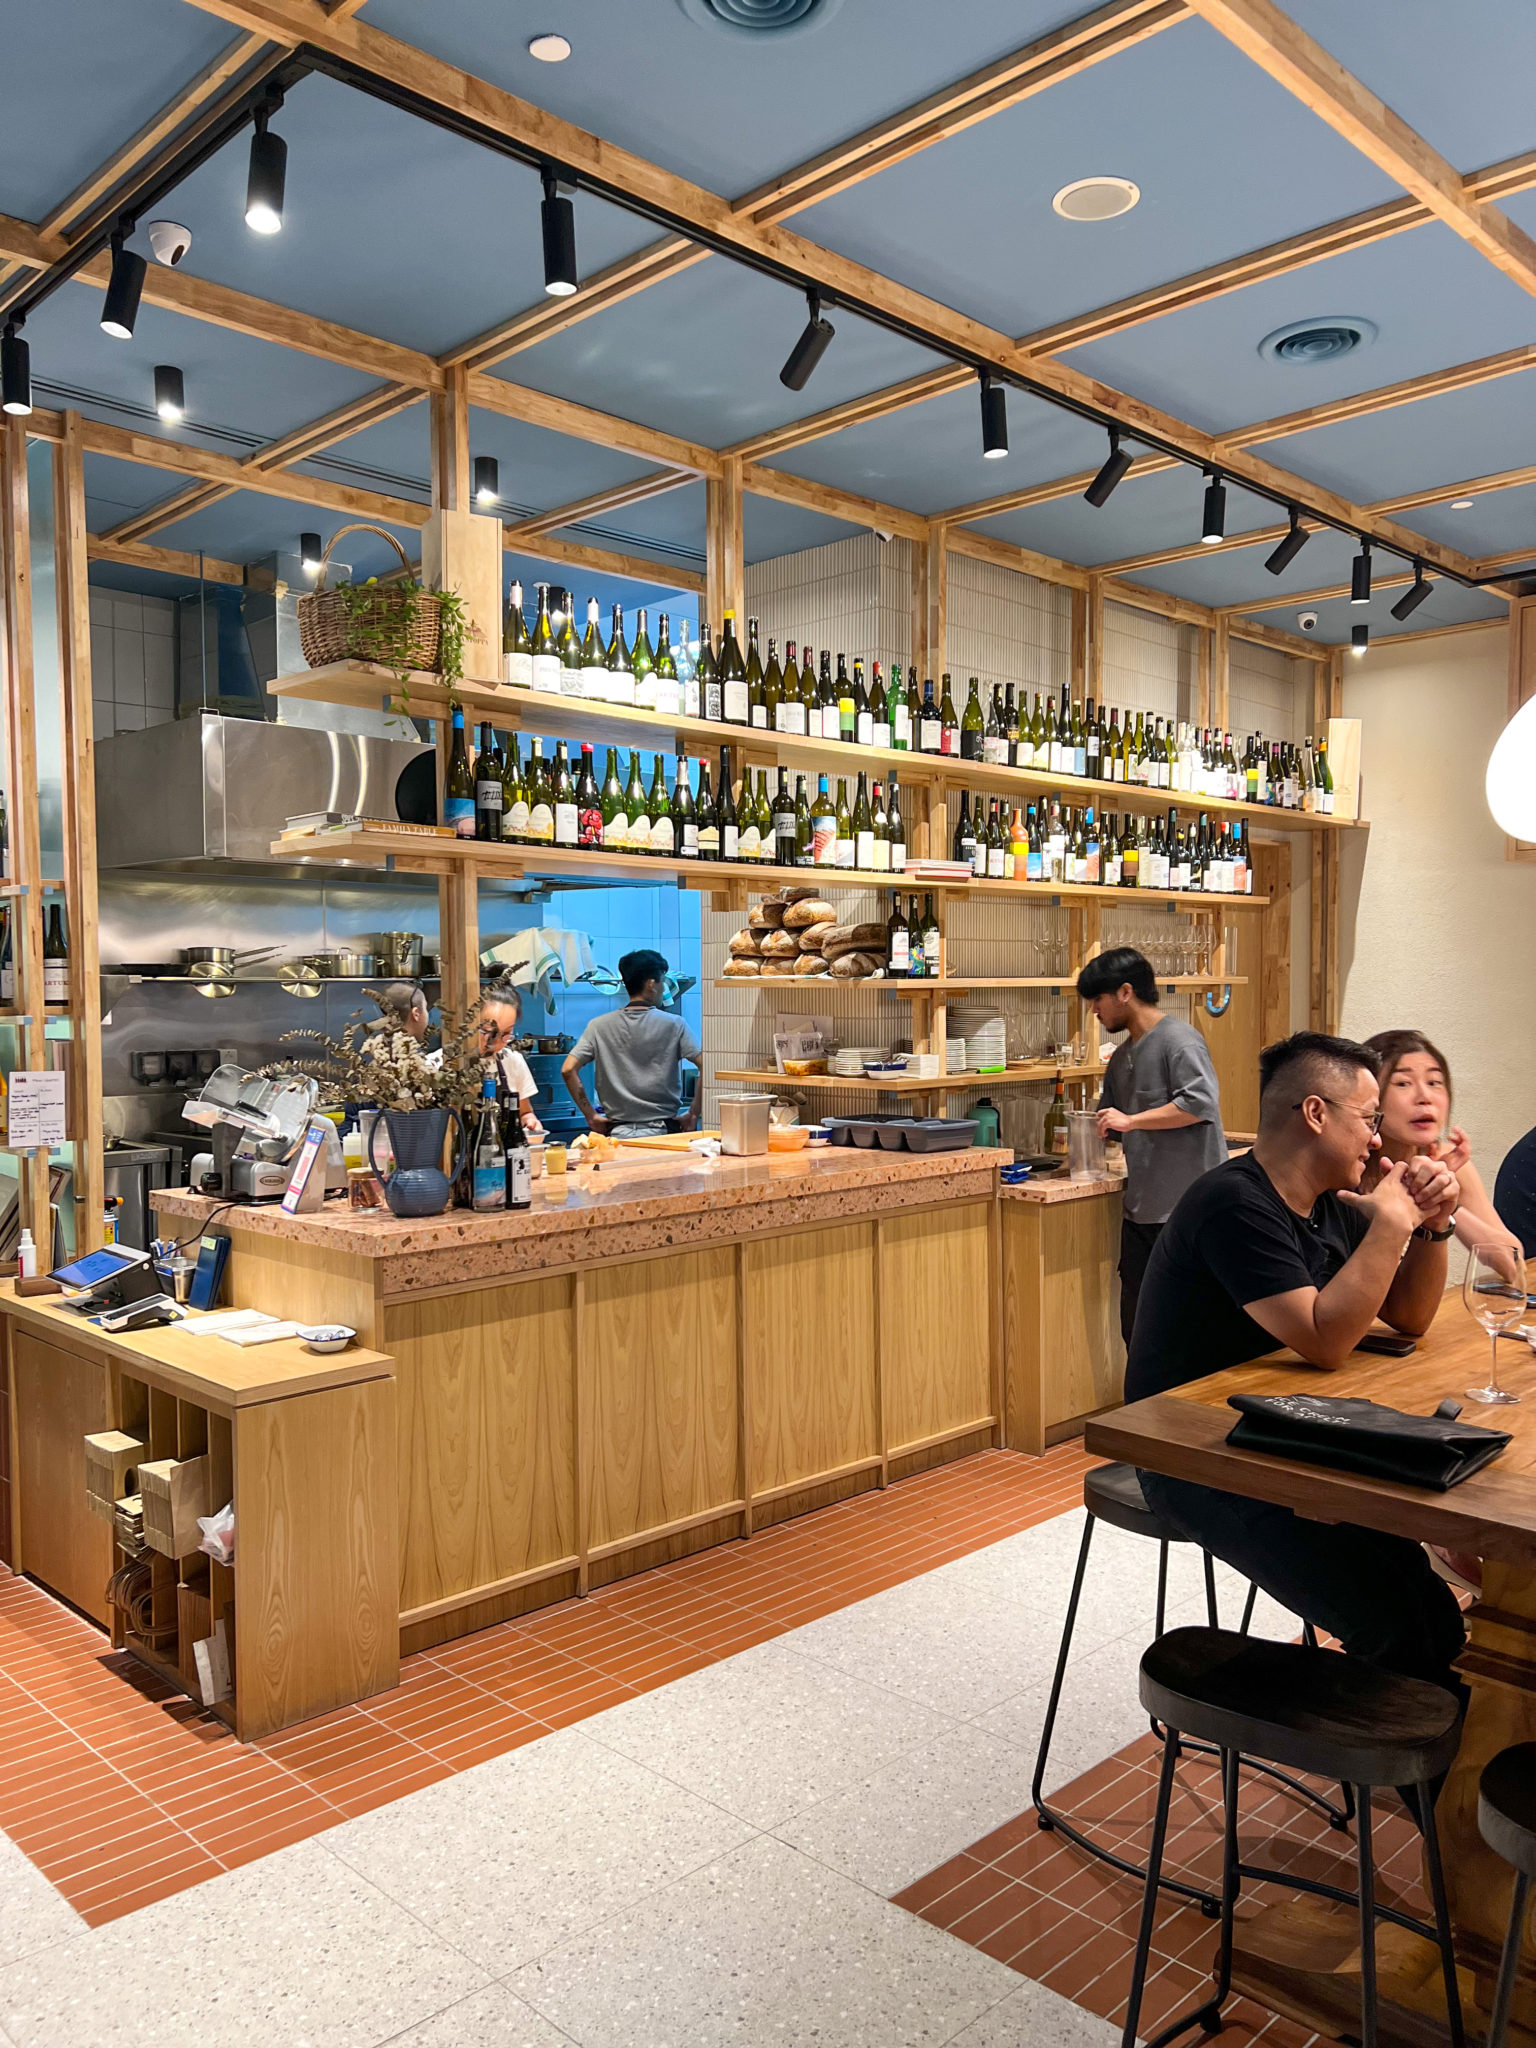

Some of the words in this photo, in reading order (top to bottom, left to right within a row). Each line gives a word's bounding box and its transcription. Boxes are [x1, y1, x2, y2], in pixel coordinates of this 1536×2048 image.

[382, 823, 411, 833] FAMILY
[413, 826, 438, 836] TABLE
[1264, 1398, 1294, 1412] FOR
